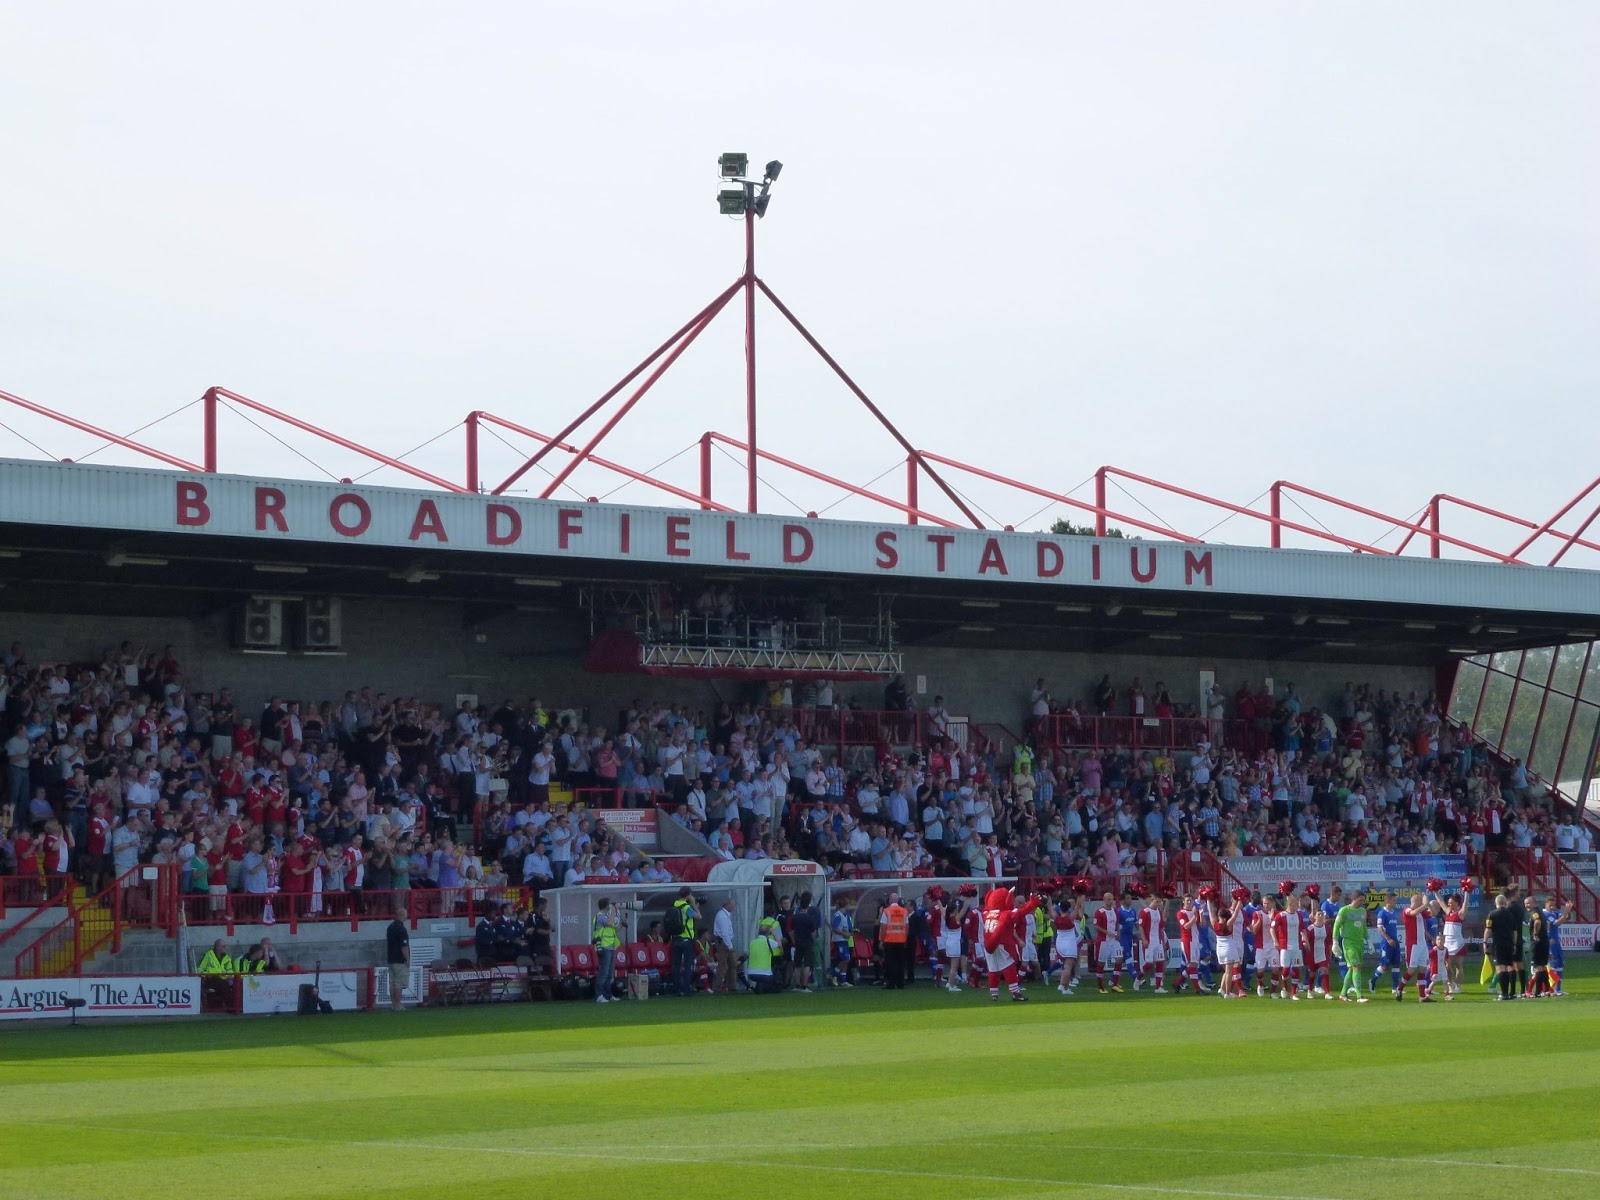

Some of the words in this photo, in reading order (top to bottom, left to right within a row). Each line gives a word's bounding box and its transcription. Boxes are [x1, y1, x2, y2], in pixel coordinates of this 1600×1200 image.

[176, 481, 814, 563] BROADFIELD
[875, 531, 1213, 586] STADIUM
[6, 986, 69, 1012] Argus
[90, 983, 129, 1005] The
[132, 983, 192, 1010] Argus
